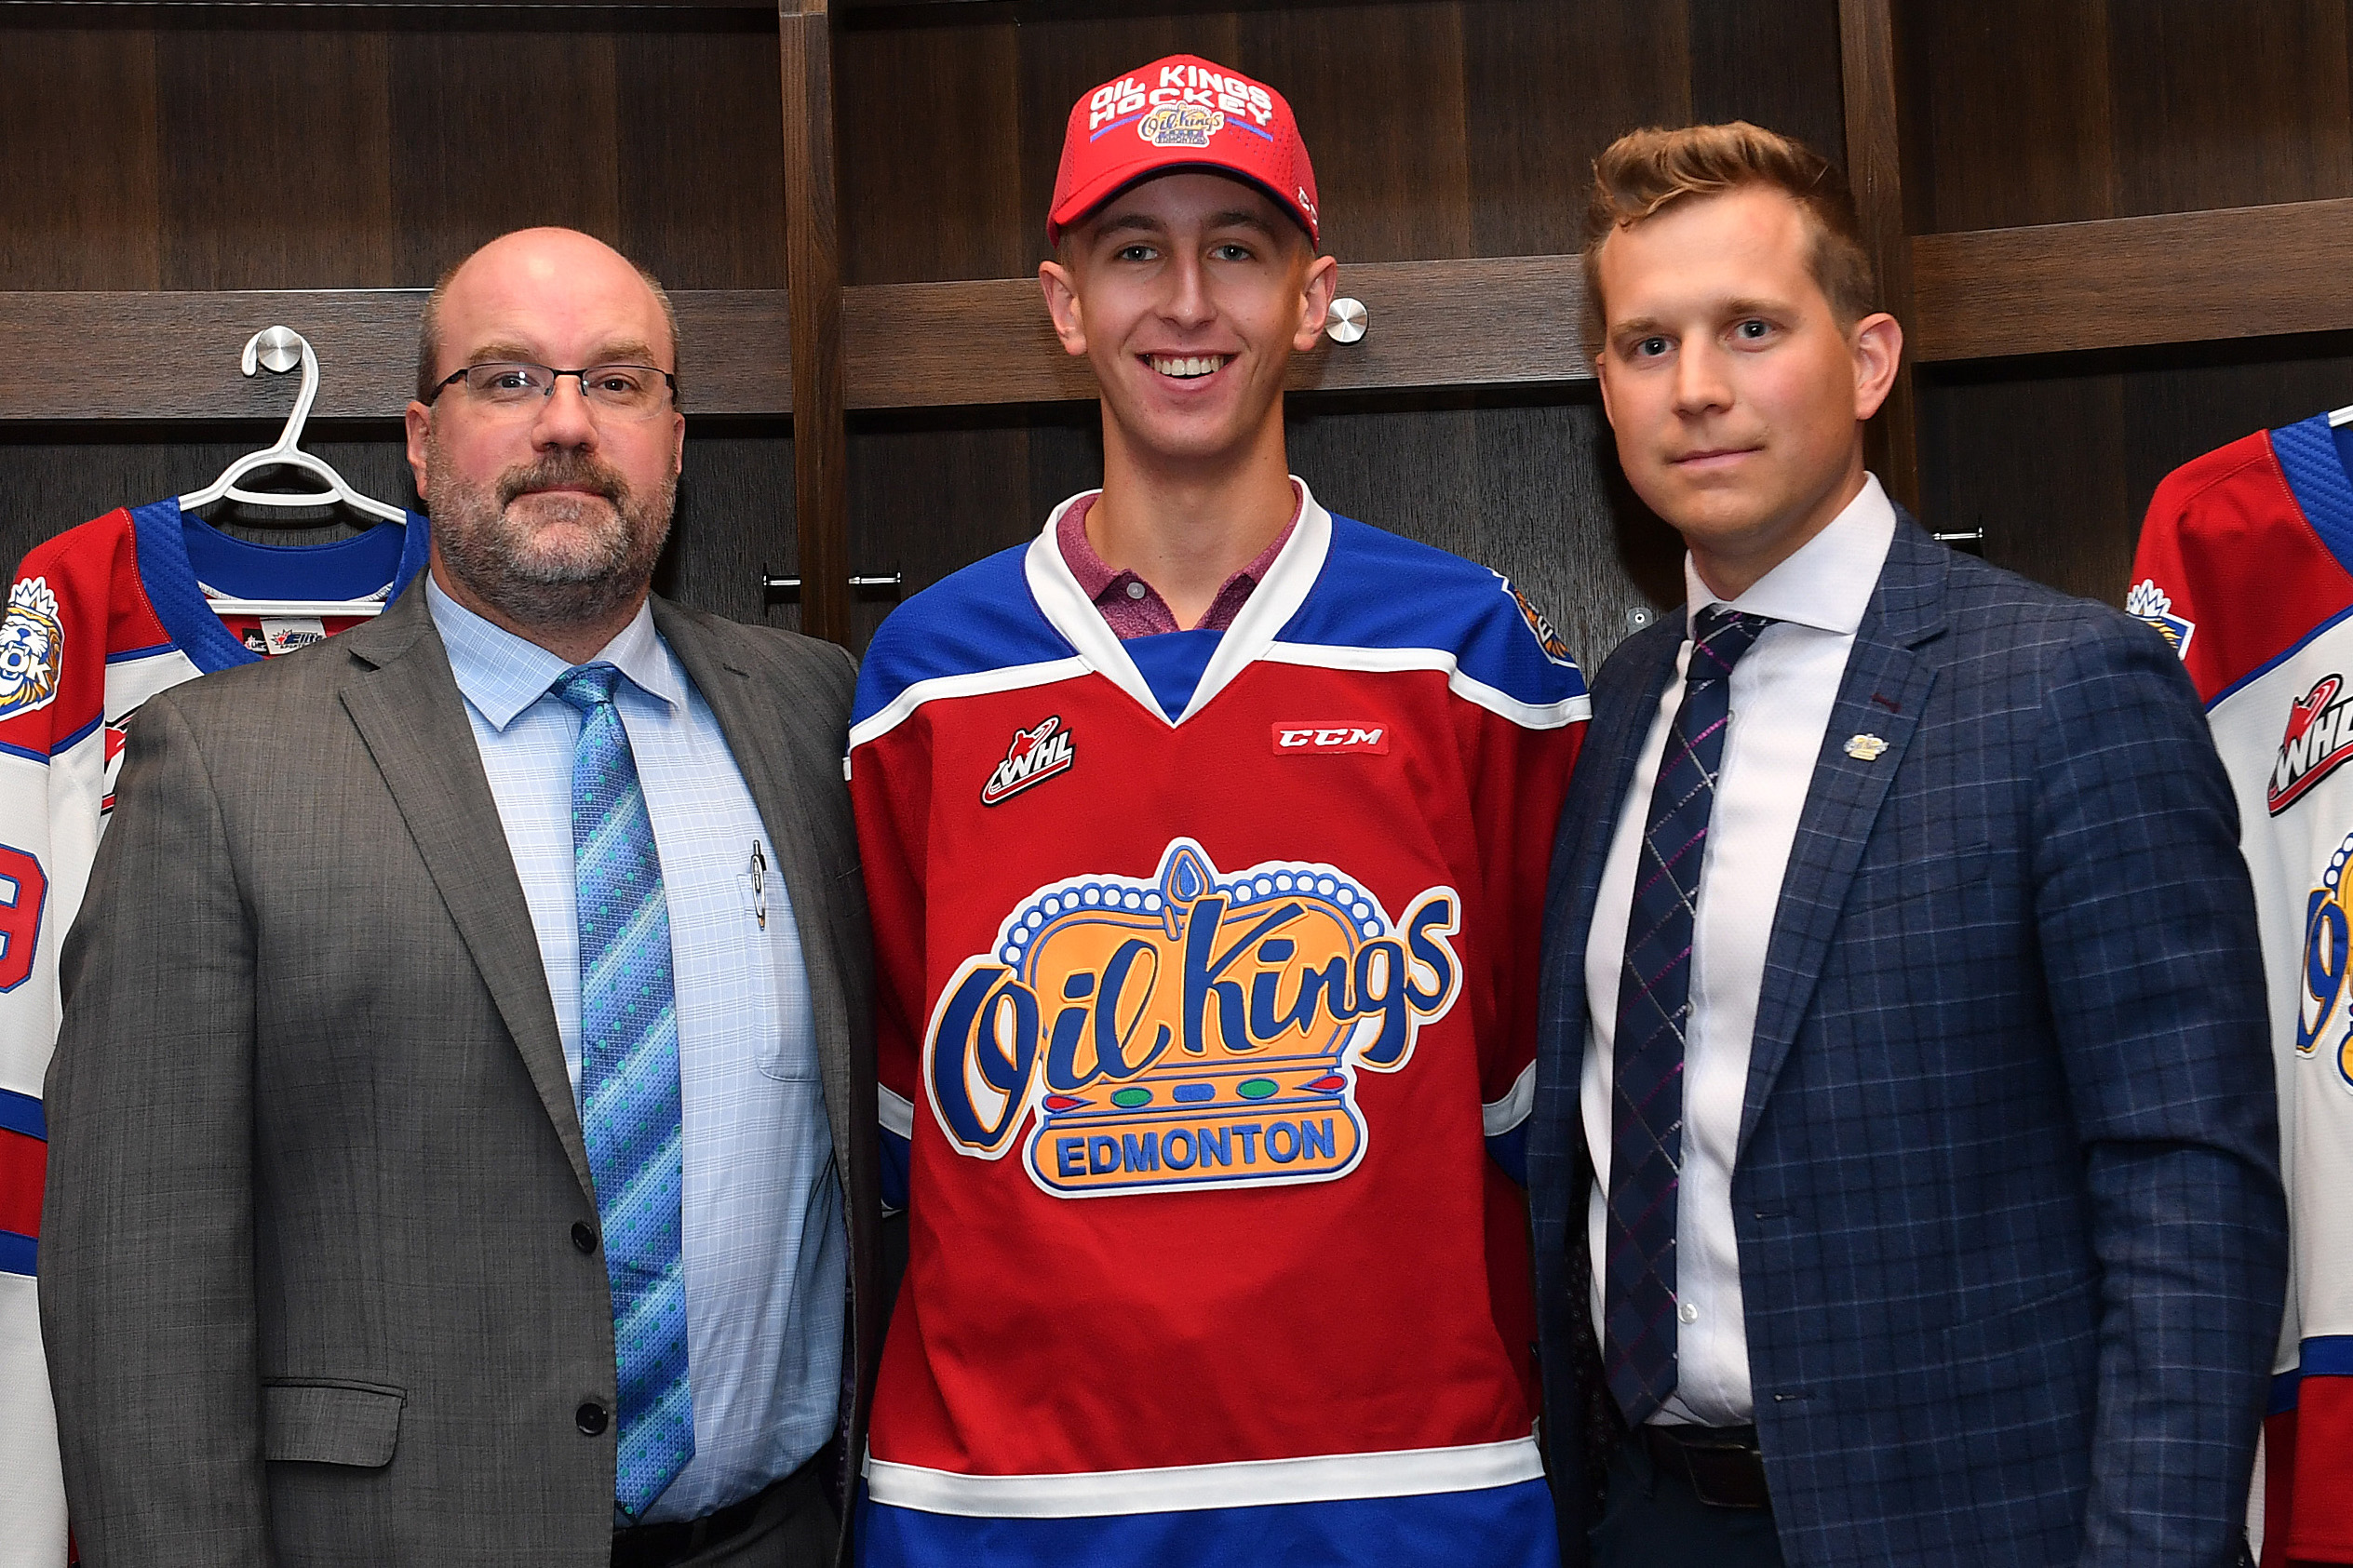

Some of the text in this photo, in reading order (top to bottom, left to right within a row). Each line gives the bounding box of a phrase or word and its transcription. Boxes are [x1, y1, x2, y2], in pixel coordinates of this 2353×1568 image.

[1090, 65, 1272, 111] OIL KINGS
[1090, 88, 1272, 130] HOCKEY
[1000, 731, 1073, 787] WHL
[1279, 729, 1383, 747] CCM
[930, 894, 1456, 1149] Oil Kings
[1056, 1118, 1336, 1178] EDMONTON
